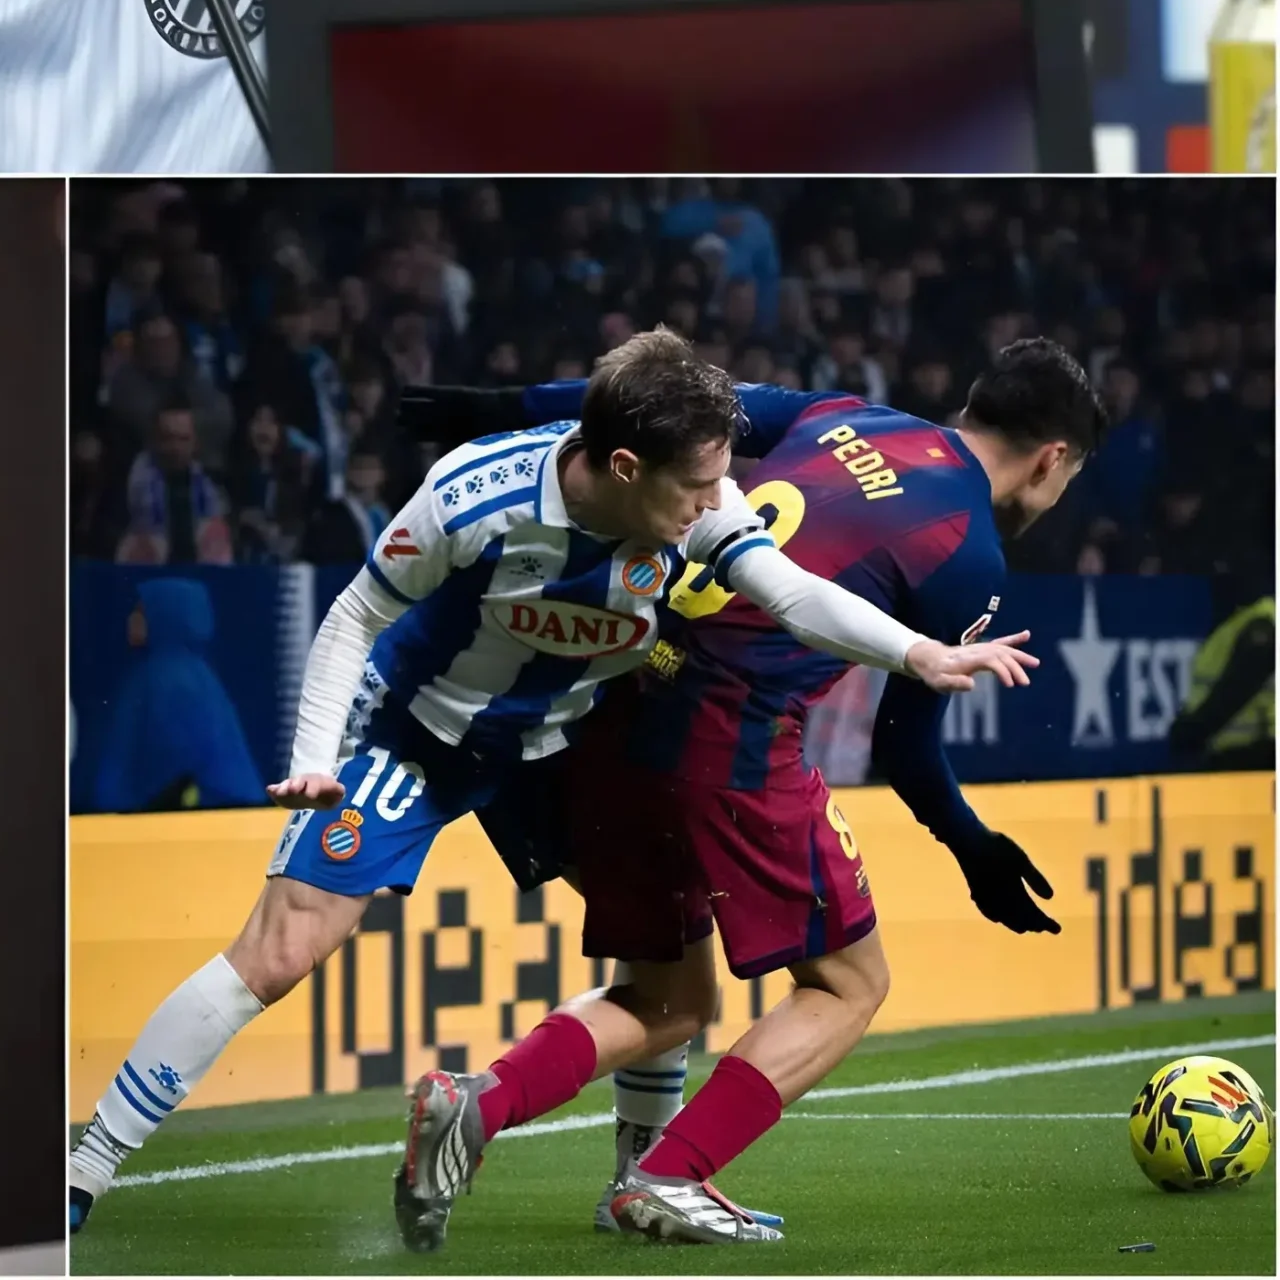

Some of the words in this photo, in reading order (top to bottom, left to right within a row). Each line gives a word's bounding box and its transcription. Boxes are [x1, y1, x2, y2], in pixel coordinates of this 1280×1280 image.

[817, 424, 904, 500] PEDRI
[508, 604, 620, 646] DANI
[350, 745, 427, 821] 10
